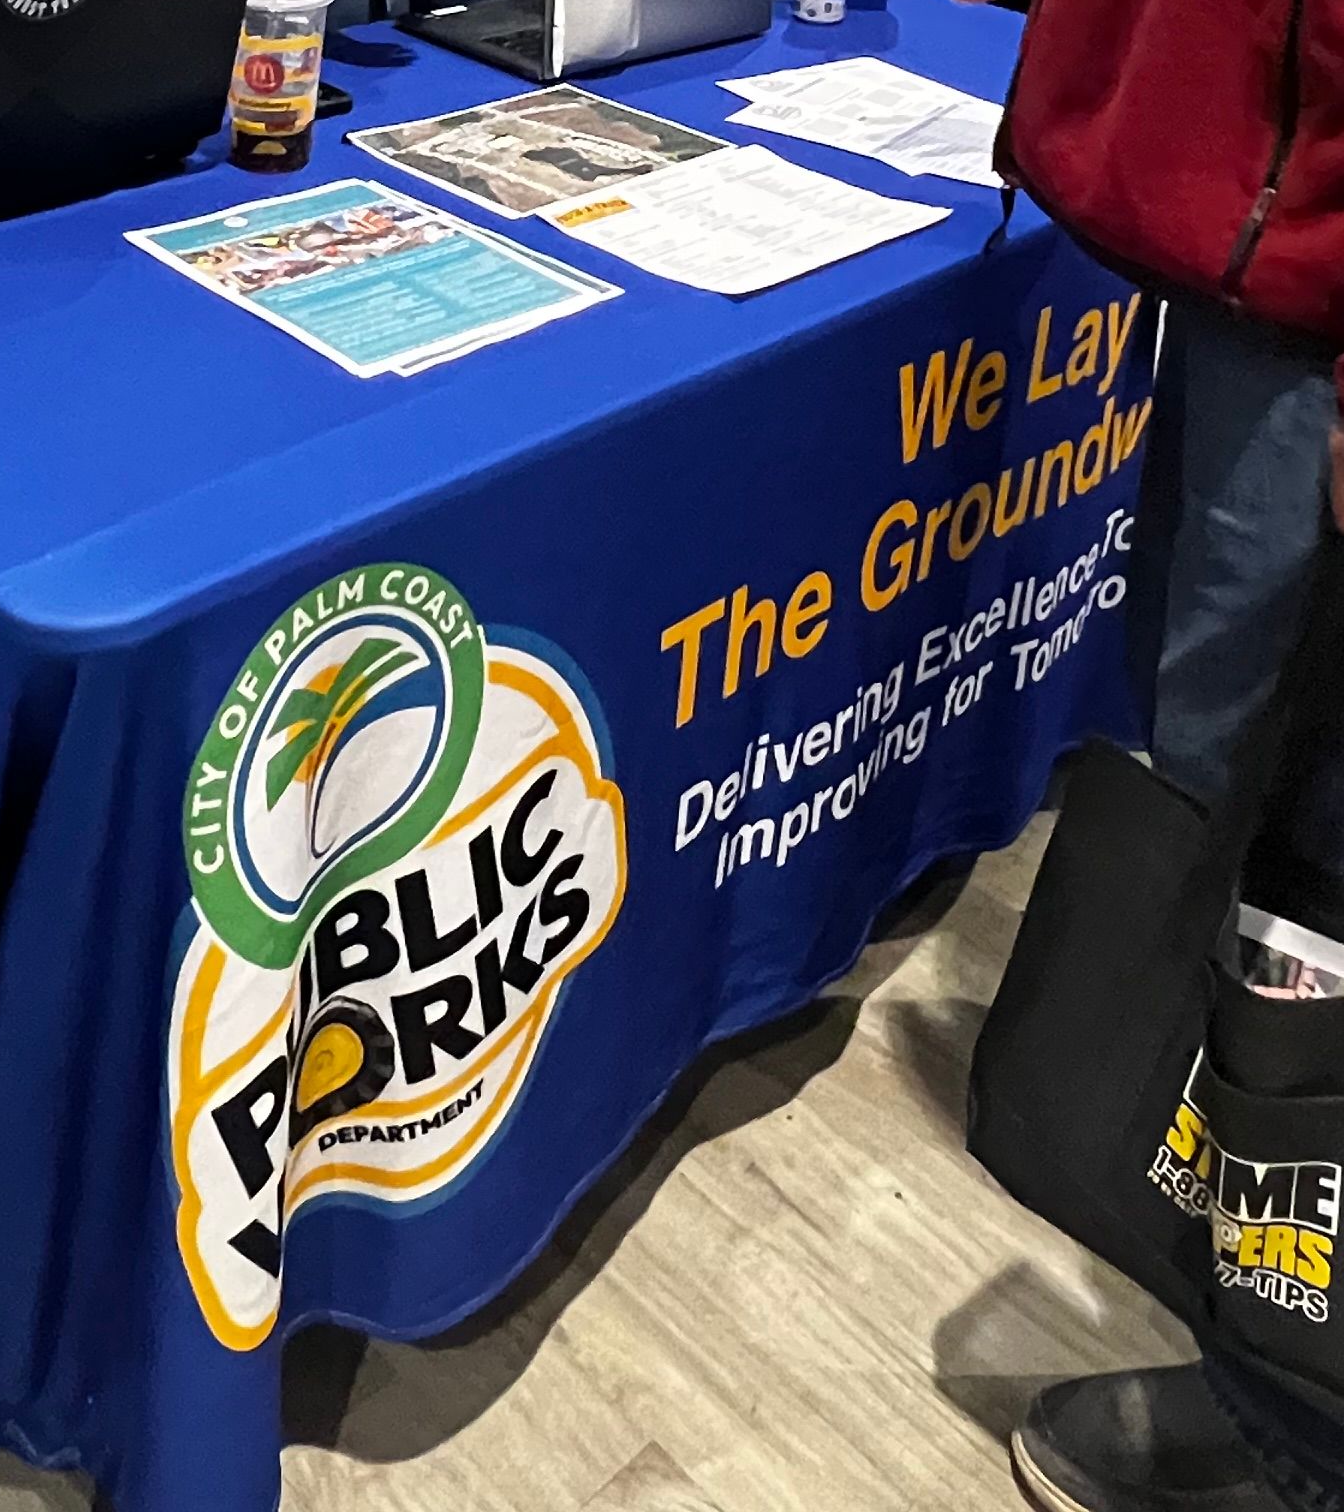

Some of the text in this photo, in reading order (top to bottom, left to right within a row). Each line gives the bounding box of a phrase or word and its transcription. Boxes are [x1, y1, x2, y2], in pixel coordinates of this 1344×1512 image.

[899, 291, 1142, 464] We Lay
[190, 569, 475, 874] CITY OF PALM COAST
[660, 570, 832, 730] The
[674, 661, 905, 852] Delivering
[913, 542, 1100, 687] Excellence
[714, 705, 933, 890] Improving
[941, 659, 994, 728] for
[211, 769, 563, 1200] PBLIC
[317, 1077, 485, 1153] DEPARTMENT
